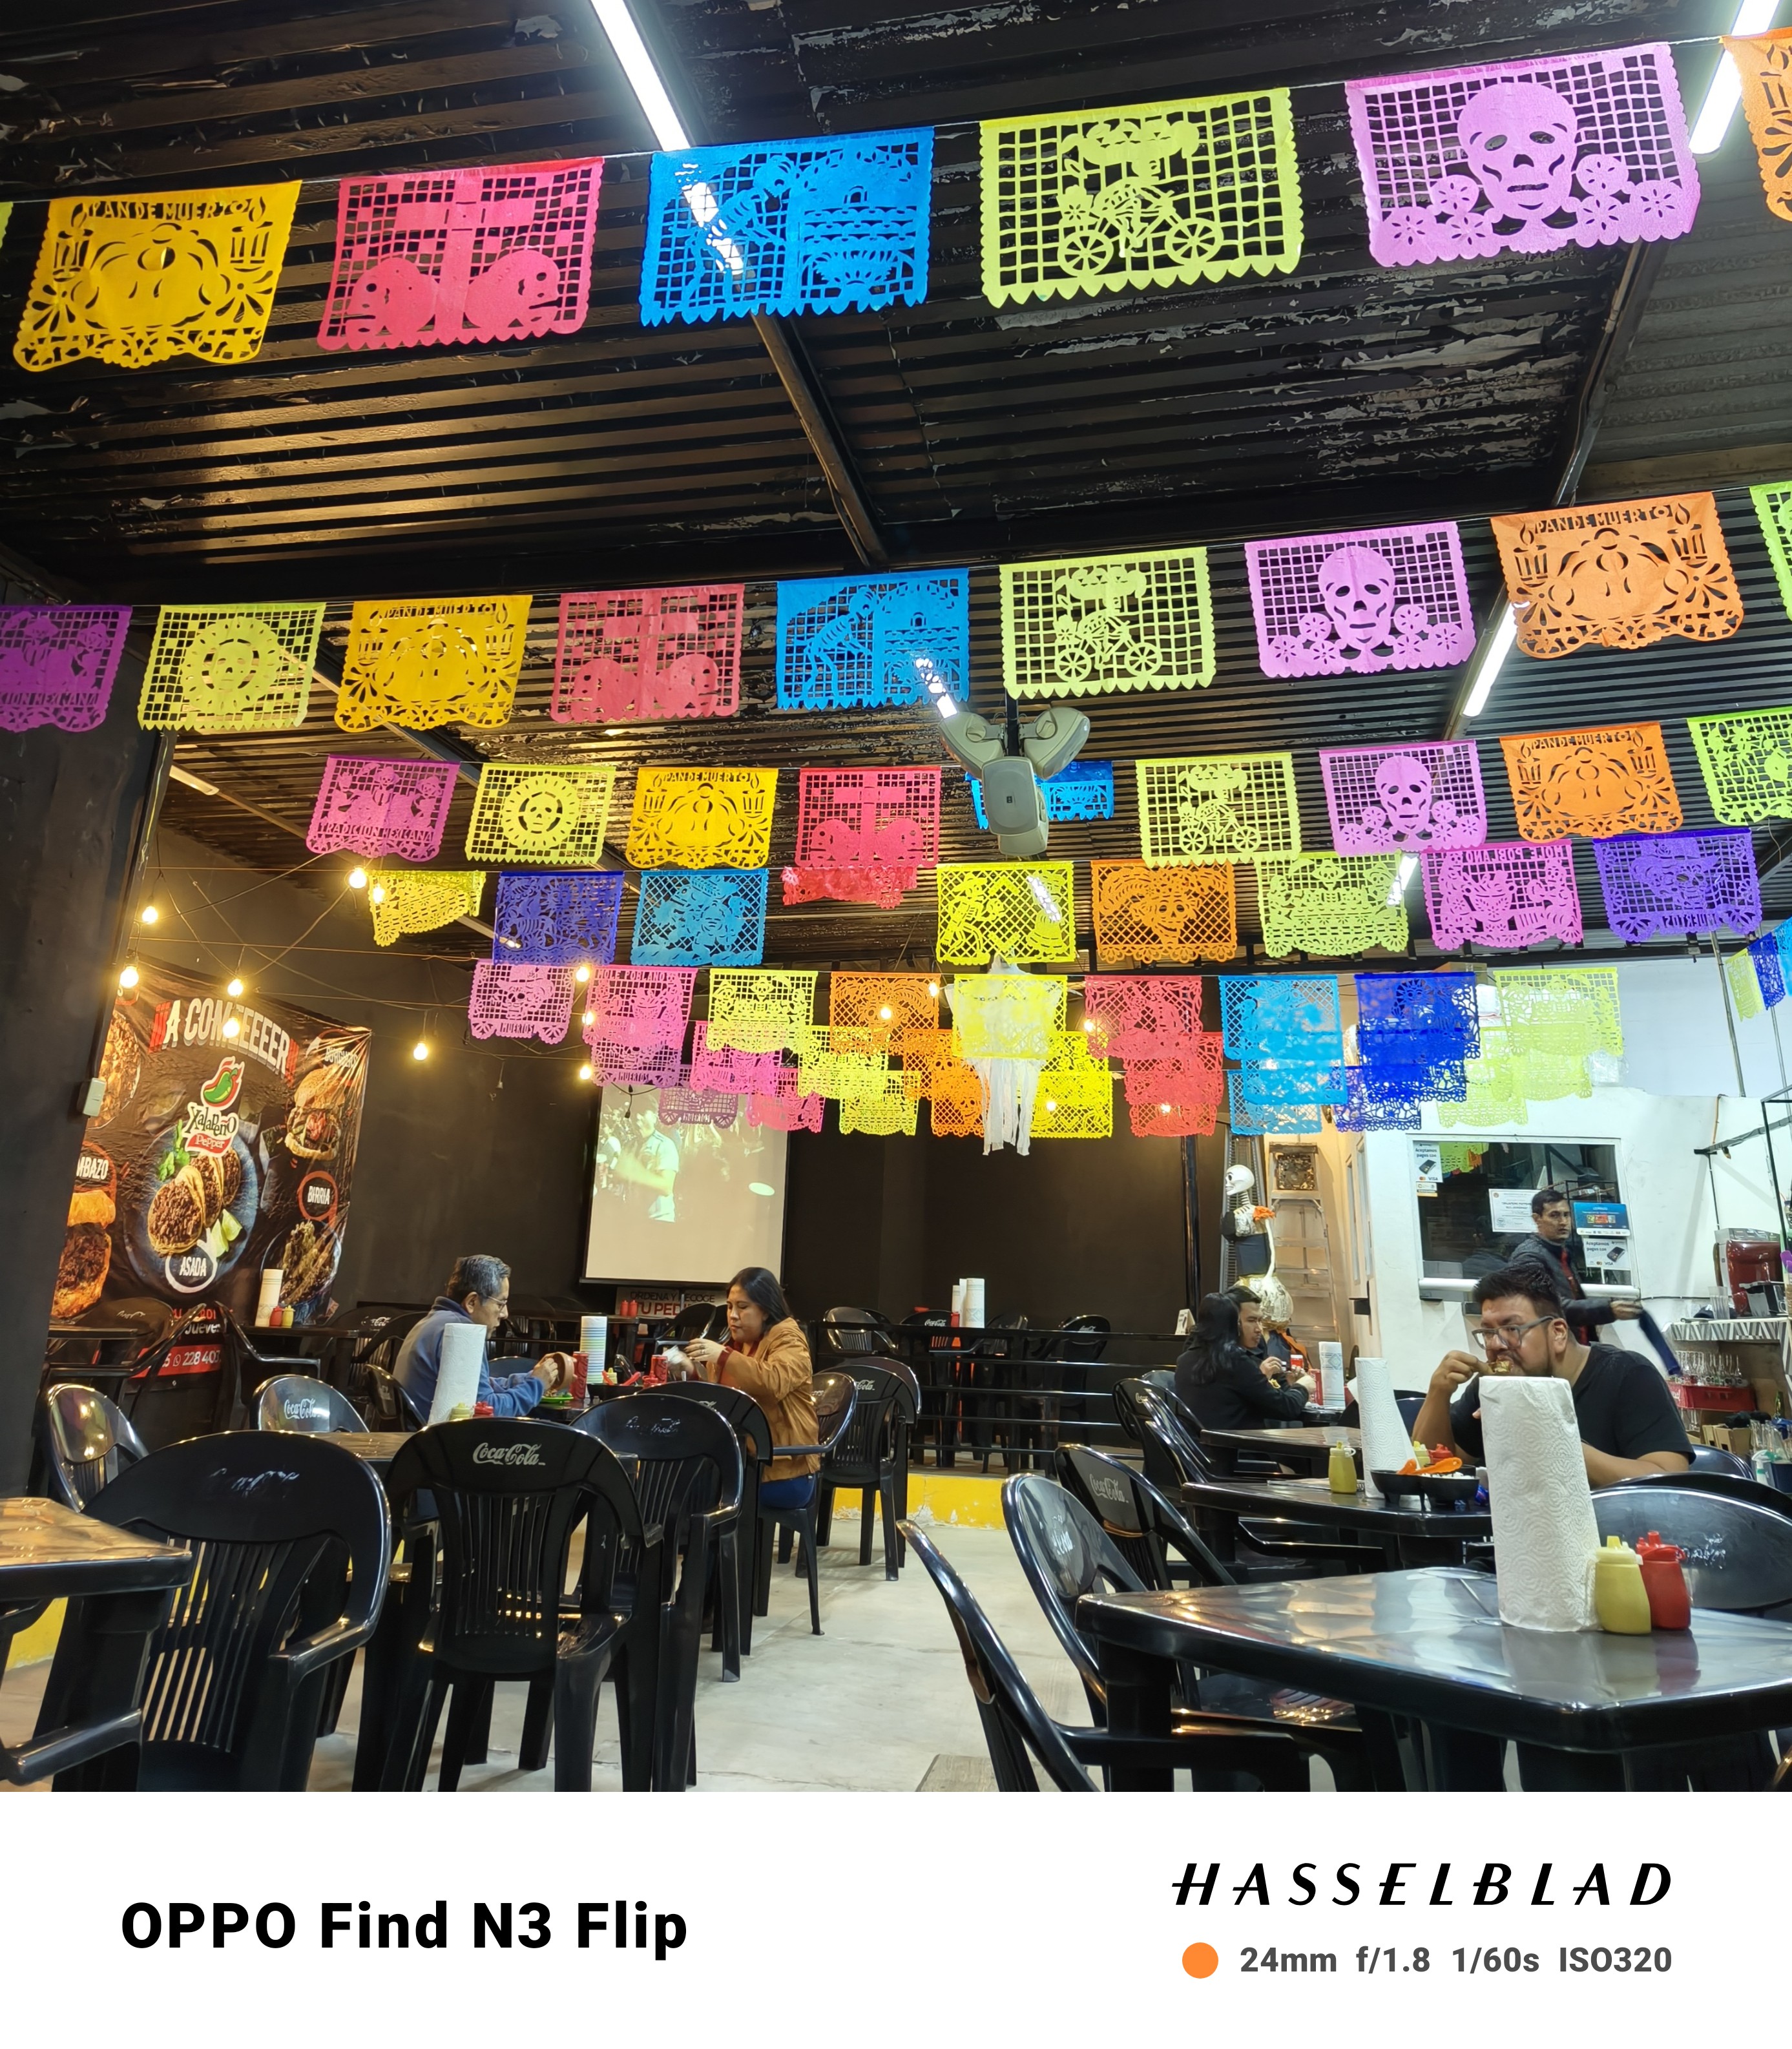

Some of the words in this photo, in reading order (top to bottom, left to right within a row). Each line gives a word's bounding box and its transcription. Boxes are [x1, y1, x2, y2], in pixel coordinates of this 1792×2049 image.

[92, 201, 129, 218] PAN
[134, 202, 156, 220] DE
[163, 198, 249, 220] MUERTO
[1536, 518, 1568, 534] PAN
[1572, 515, 1592, 529] DE
[1597, 505, 1669, 525] MUERTO
[1532, 738, 1556, 749] PAN
[1559, 736, 1570, 747] DE
[1576, 731, 1630, 745] MUERTO
[664, 772, 685, 782] PAN
[689, 772, 700, 782] DE
[703, 772, 750, 782] MUERTO
[194, 1134, 225, 1149] Pepper
[76, 1156, 109, 1180] MBAZO
[307, 1185, 331, 1205] BIRRIA
[179, 1256, 207, 1277] ASADA
[182, 1351, 202, 1366] 228
